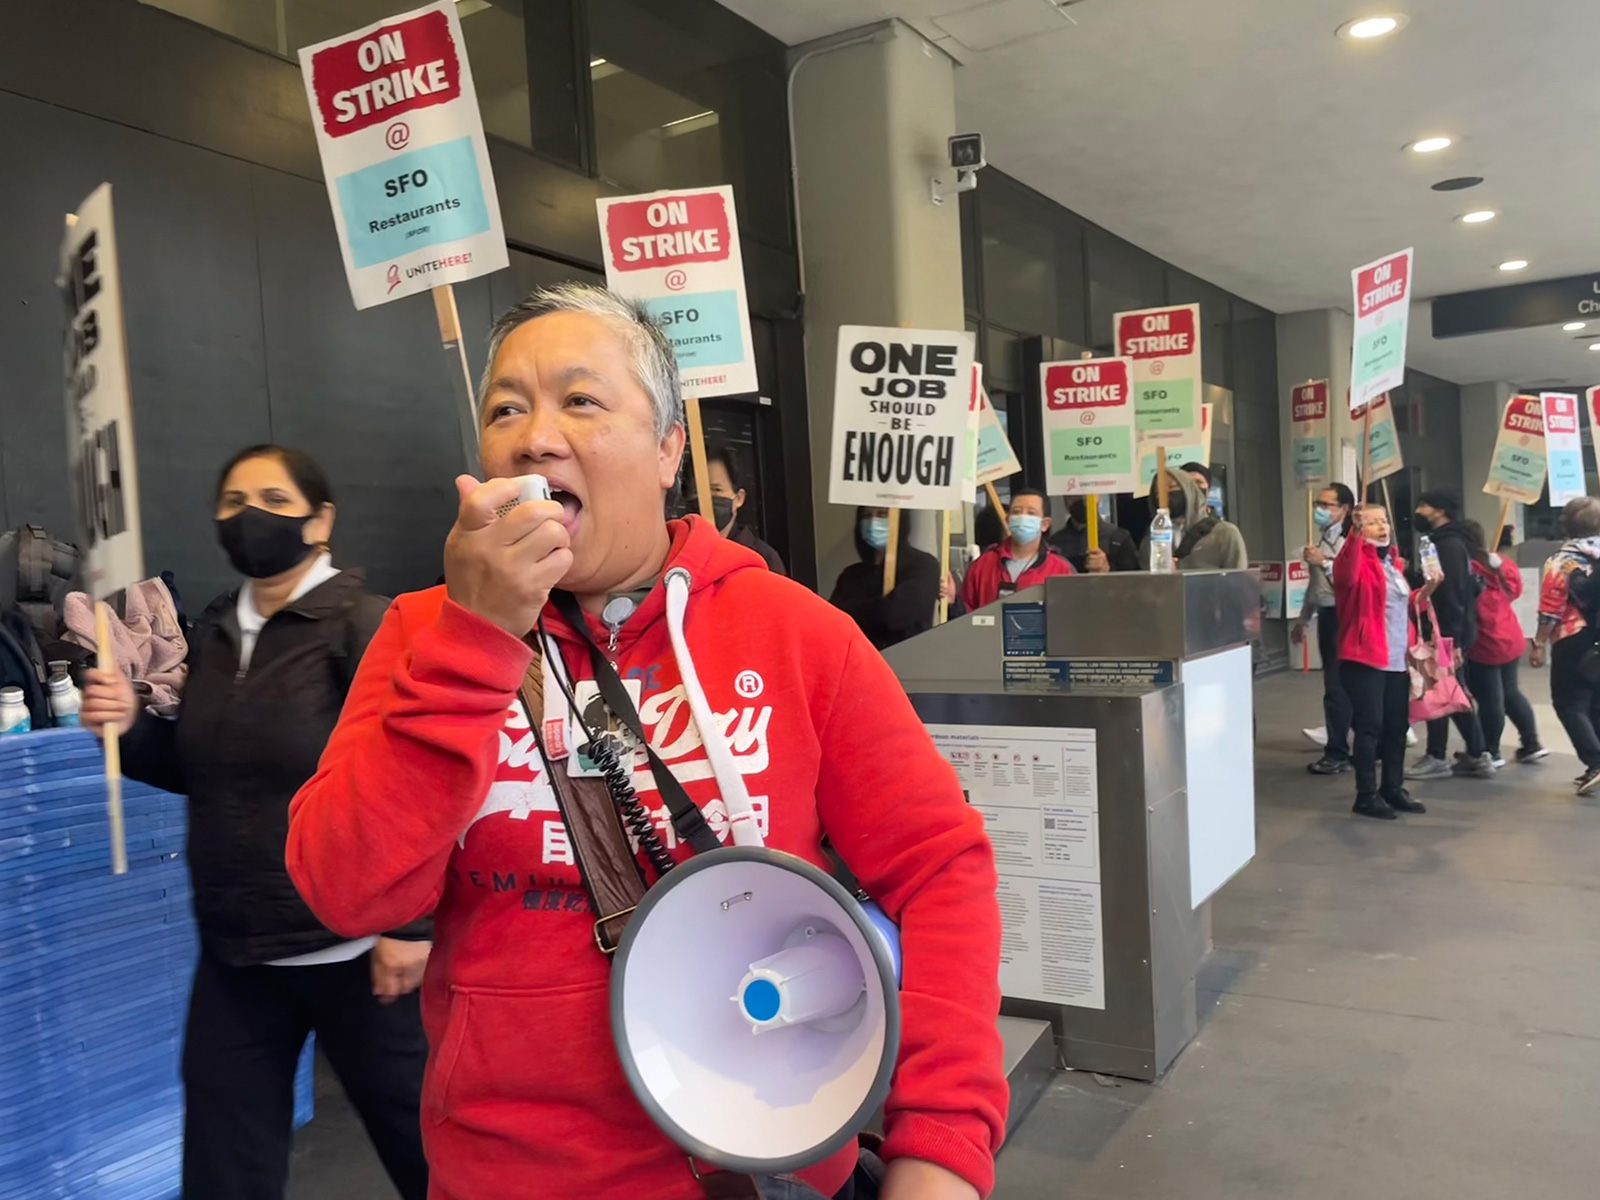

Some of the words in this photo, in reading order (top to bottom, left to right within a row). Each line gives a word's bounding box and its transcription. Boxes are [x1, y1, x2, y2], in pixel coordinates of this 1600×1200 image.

[357, 29, 407, 73] ON
[331, 58, 450, 124] STRIKE
[384, 121, 411, 151] @
[384, 169, 429, 198] SFO
[368, 197, 462, 234] Restaurants
[646, 201, 688, 228] ON
[621, 228, 722, 263] STRIKE
[664, 269, 688, 291] @
[1374, 263, 1392, 284] ON
[1361, 278, 1403, 312] STRIKE
[661, 308, 700, 325] SFO
[1141, 315, 1170, 332] ON
[670, 333, 723, 348] taurants
[1125, 333, 1189, 355] STRIKE
[850, 341, 958, 377] ONE
[681, 375, 727, 388] NITEHERE!
[1071, 366, 1100, 384] ON
[860, 377, 947, 399] JOB
[1053, 384, 1121, 405] STRIKE
[1142, 390, 1168, 401] SFO
[1301, 386, 1315, 402] ON
[869, 400, 937, 416] SHOULD
[1080, 411, 1096, 425] @
[1294, 401, 1325, 418] STRIKE
[891, 417, 912, 431] BE
[1076, 436, 1103, 447] SFO
[842, 430, 955, 487] ENOUGH
[1511, 453, 1529, 466] SFO
